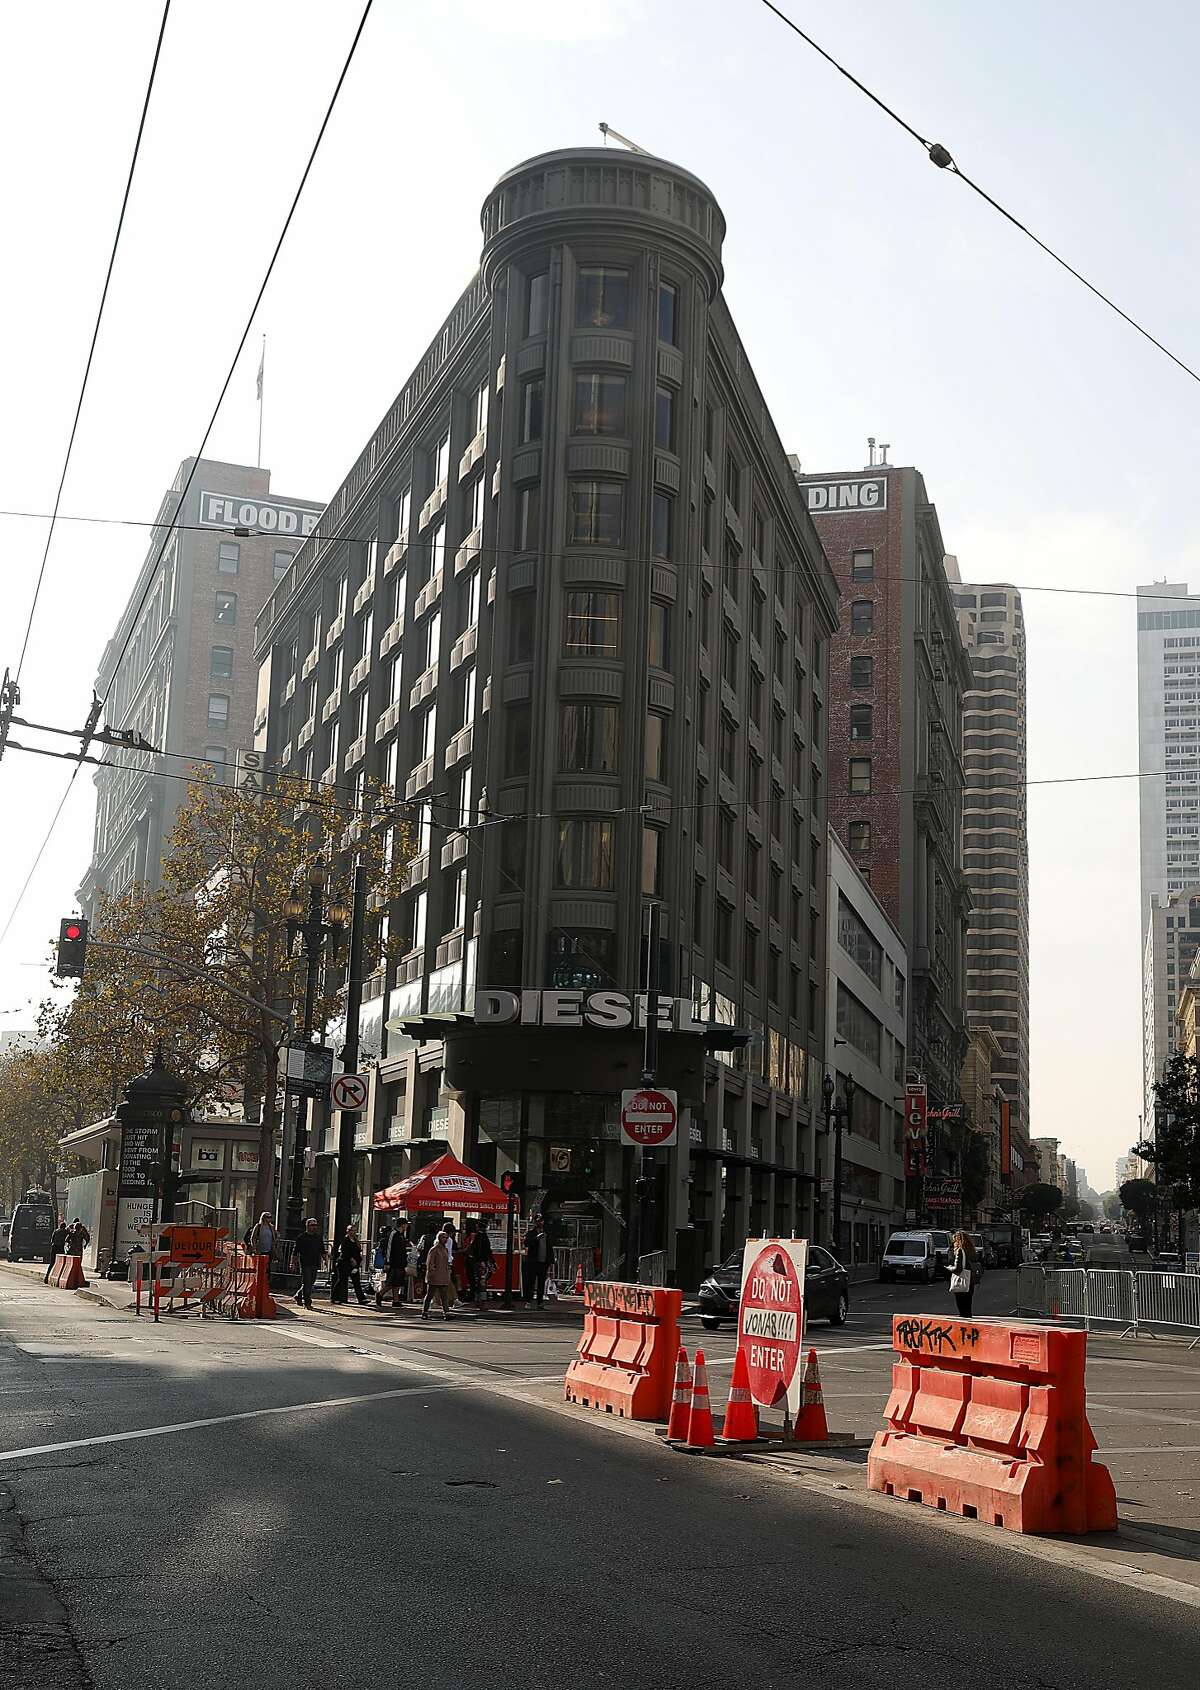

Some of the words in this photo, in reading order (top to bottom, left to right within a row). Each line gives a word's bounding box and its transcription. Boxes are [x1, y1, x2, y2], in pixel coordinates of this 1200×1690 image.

[808, 482, 879, 509] DING
[208, 498, 297, 533] FLOOD
[474, 990, 707, 1035] DIESEL
[631, 1102, 646, 1111] DO
[650, 1102, 667, 1111] NOT
[634, 1124, 663, 1134] ENTER
[751, 1277, 766, 1301] DO
[771, 1279, 793, 1302] NOT
[750, 1345, 785, 1373] ENTER
